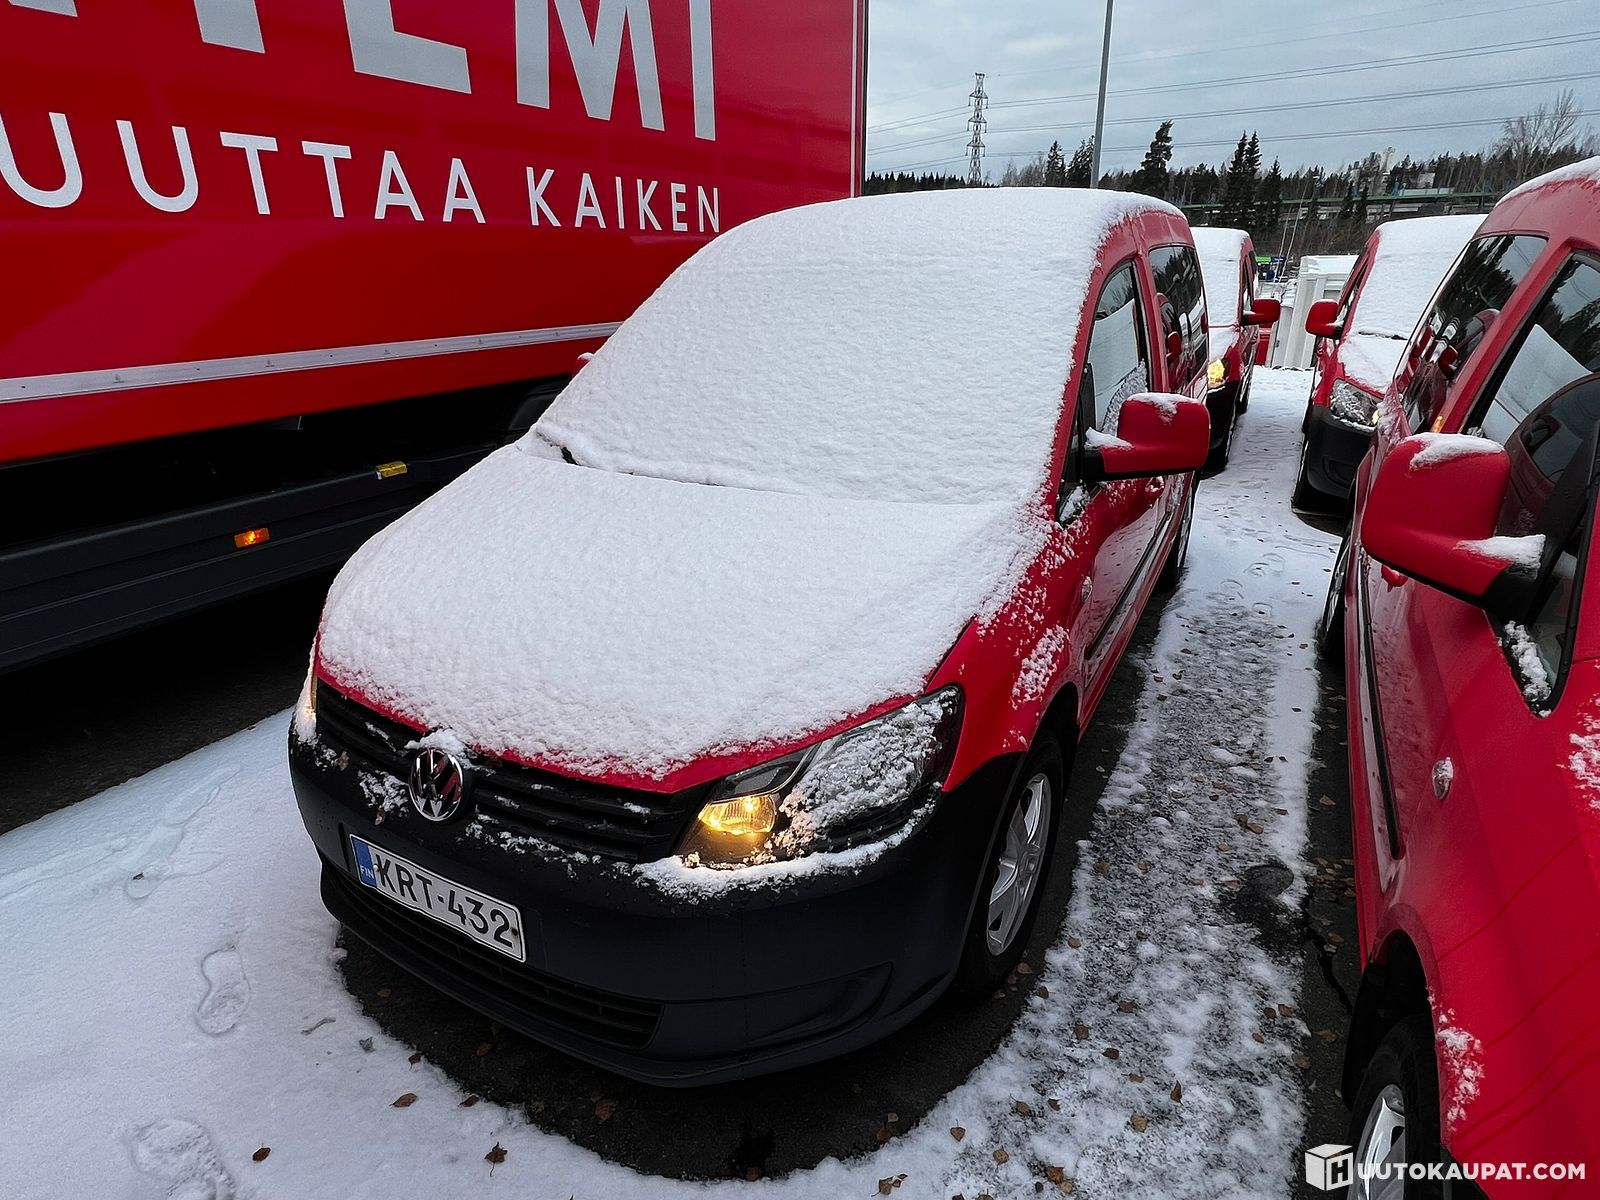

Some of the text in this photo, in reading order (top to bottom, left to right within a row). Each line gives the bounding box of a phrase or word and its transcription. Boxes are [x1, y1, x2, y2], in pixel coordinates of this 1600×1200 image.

[526, 166, 721, 233] KAIKEN
[360, 864, 375, 881] FIN
[375, 853, 514, 949] KRT-432
